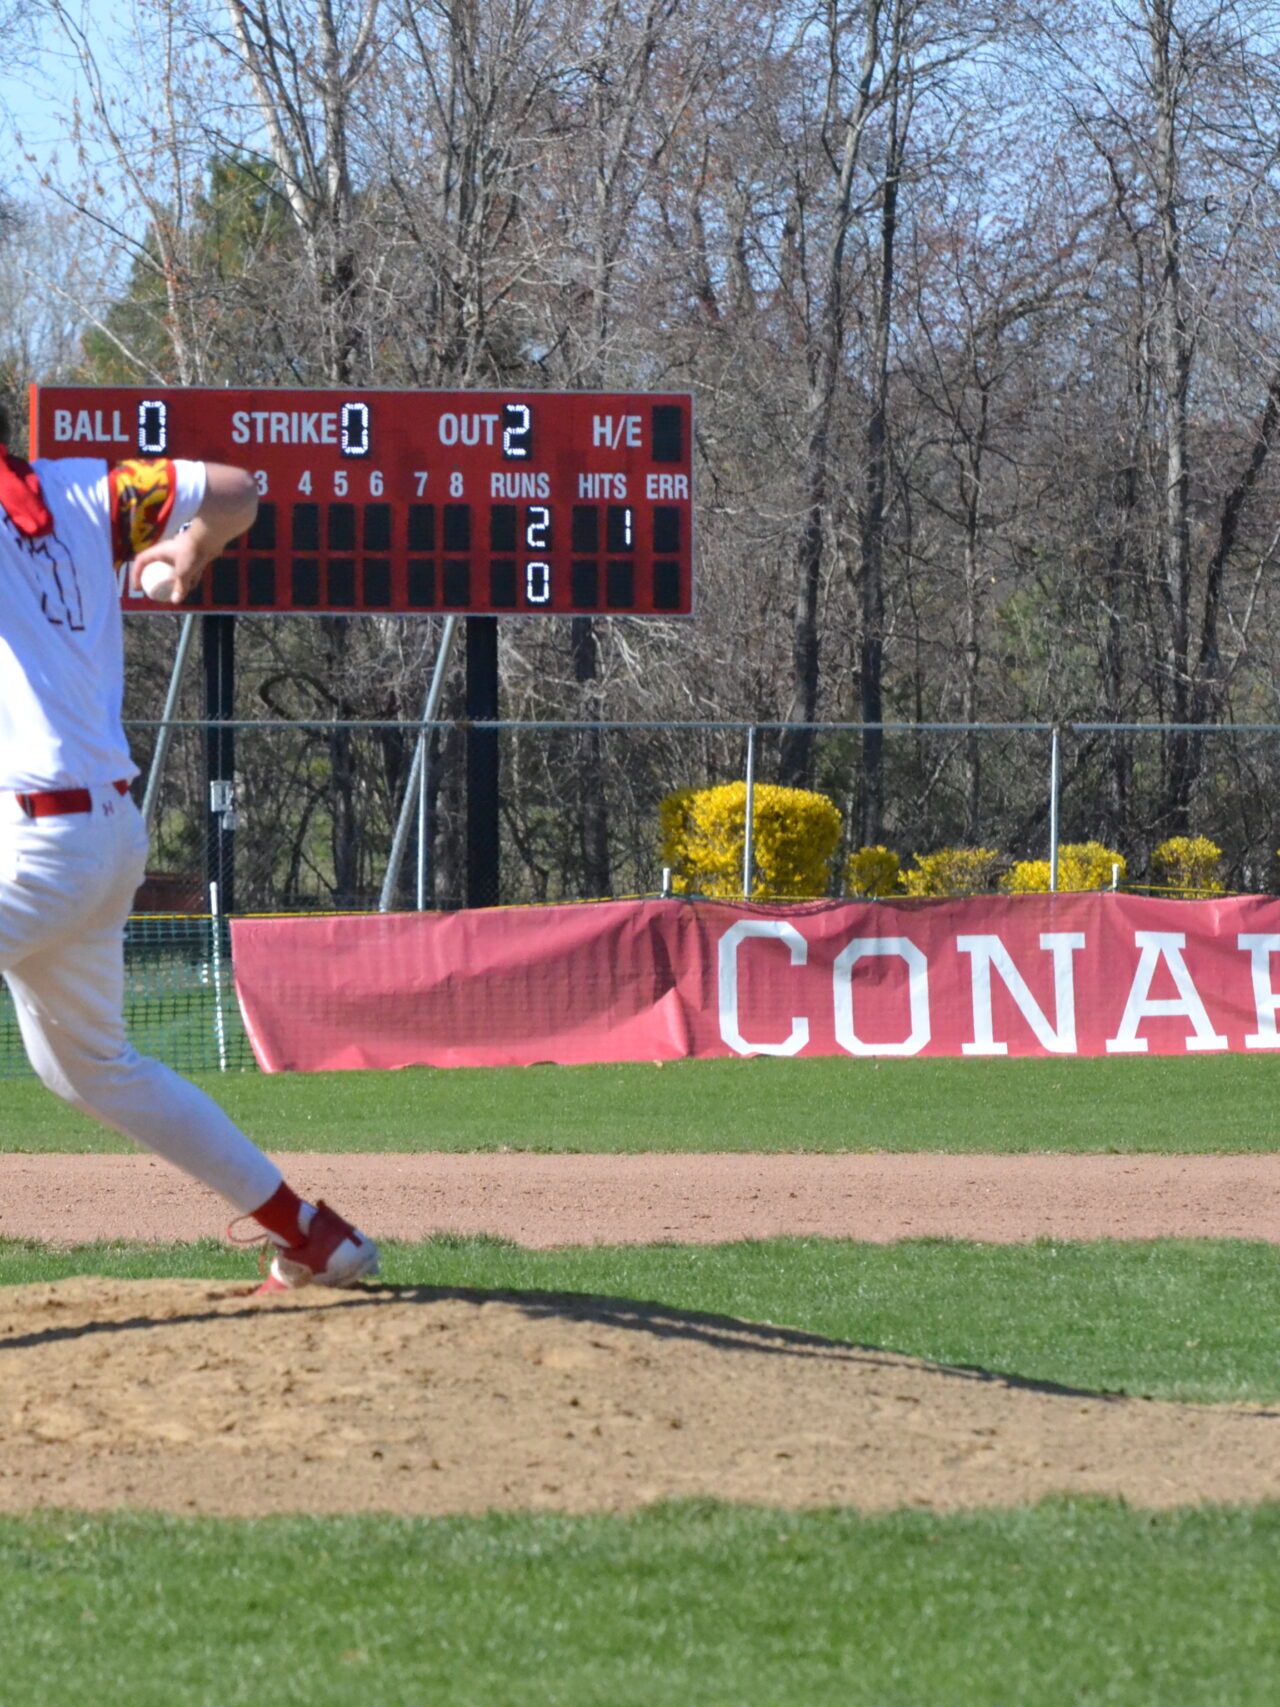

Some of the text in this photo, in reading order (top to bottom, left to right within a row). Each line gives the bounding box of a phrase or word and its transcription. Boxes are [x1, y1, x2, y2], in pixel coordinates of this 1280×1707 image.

[54, 401, 166, 452] BALL 0
[231, 403, 368, 454] STRIKE 0
[438, 404, 530, 455] OUT 2
[592, 415, 642, 450] H/E
[253, 470, 688, 499] 3 4 5 6 7 8 RUNS HITS ERR
[526, 506, 631, 547] 2 1
[526, 562, 550, 602] 0
